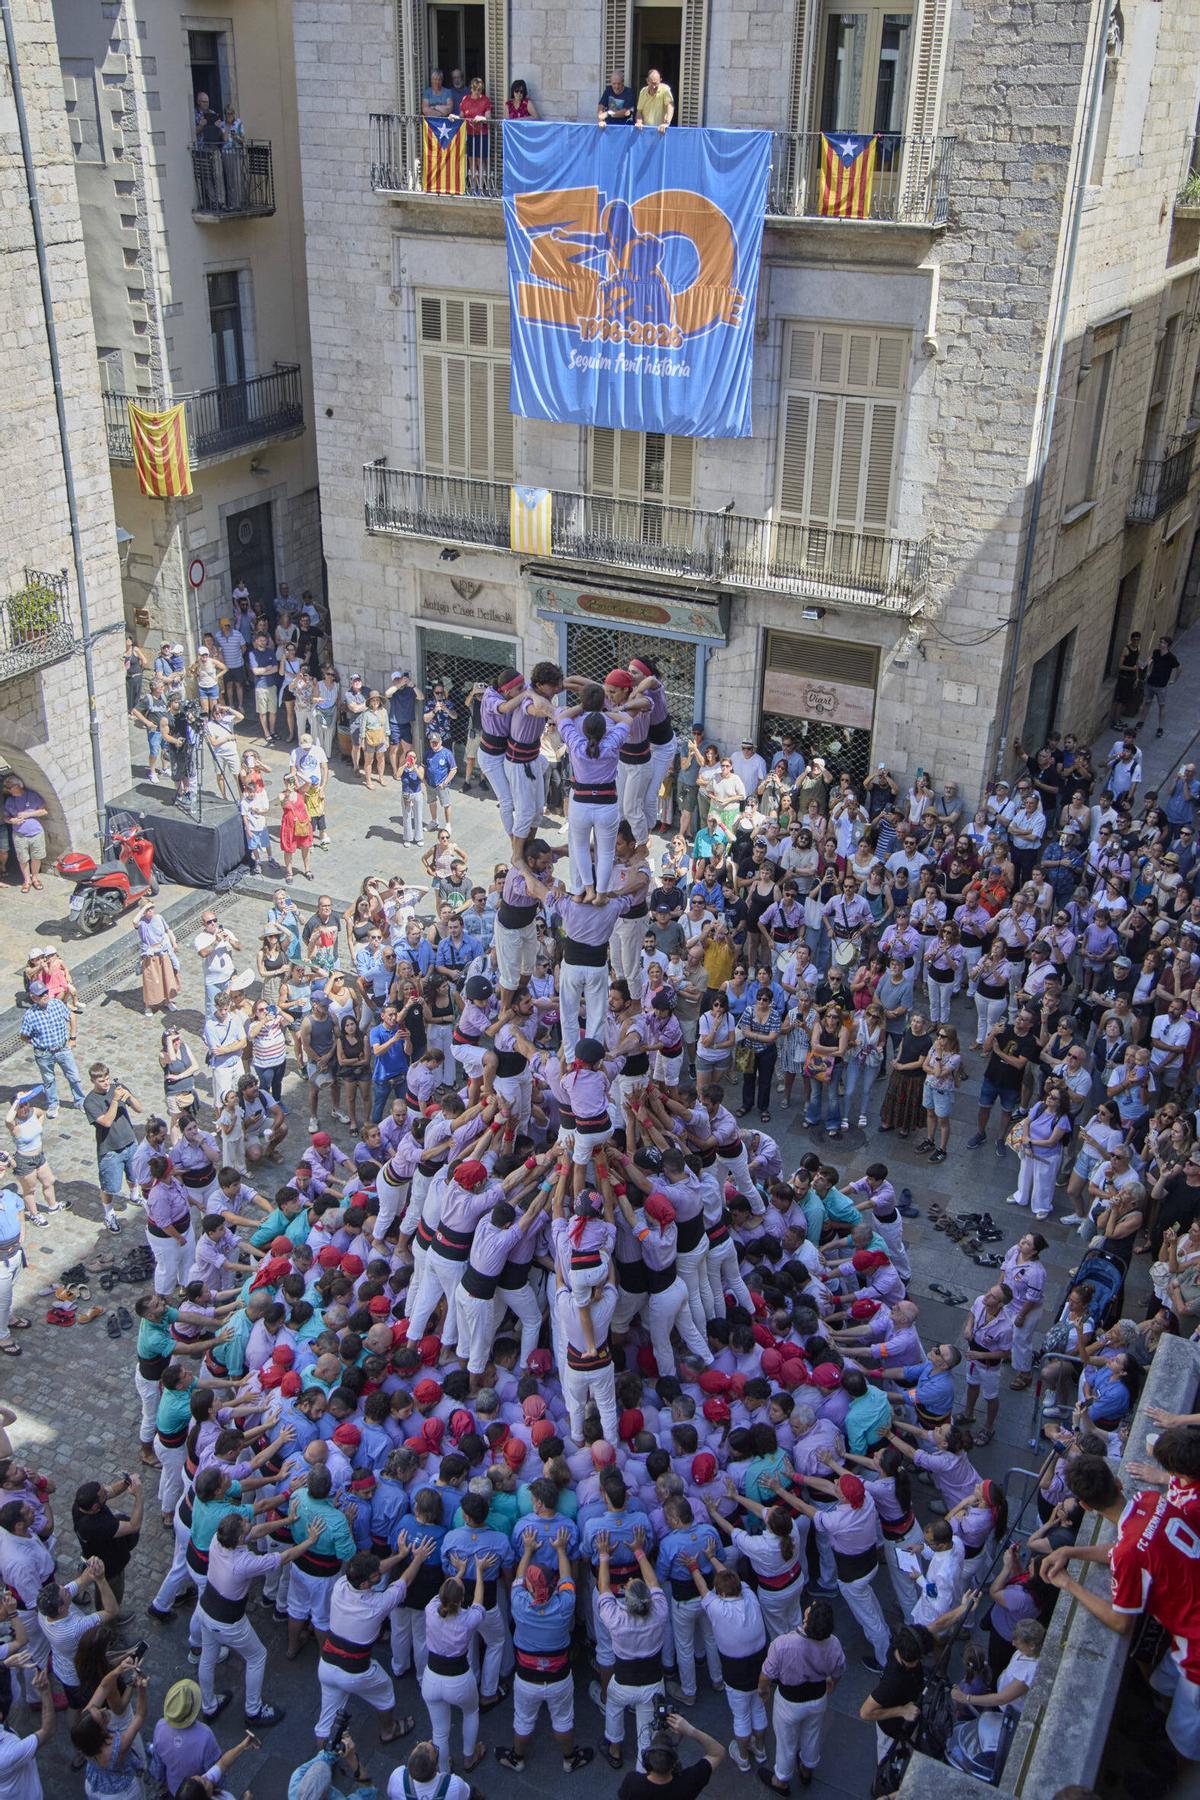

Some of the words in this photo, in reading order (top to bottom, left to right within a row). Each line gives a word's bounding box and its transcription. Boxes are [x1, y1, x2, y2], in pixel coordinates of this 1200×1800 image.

[577, 317, 684, 349] 1996-2026
[568, 348, 611, 373] Seguim
[614, 351, 645, 375] fent
[1142, 1515, 1162, 1541] BAYERN
[1137, 1538, 1149, 1552] FC
